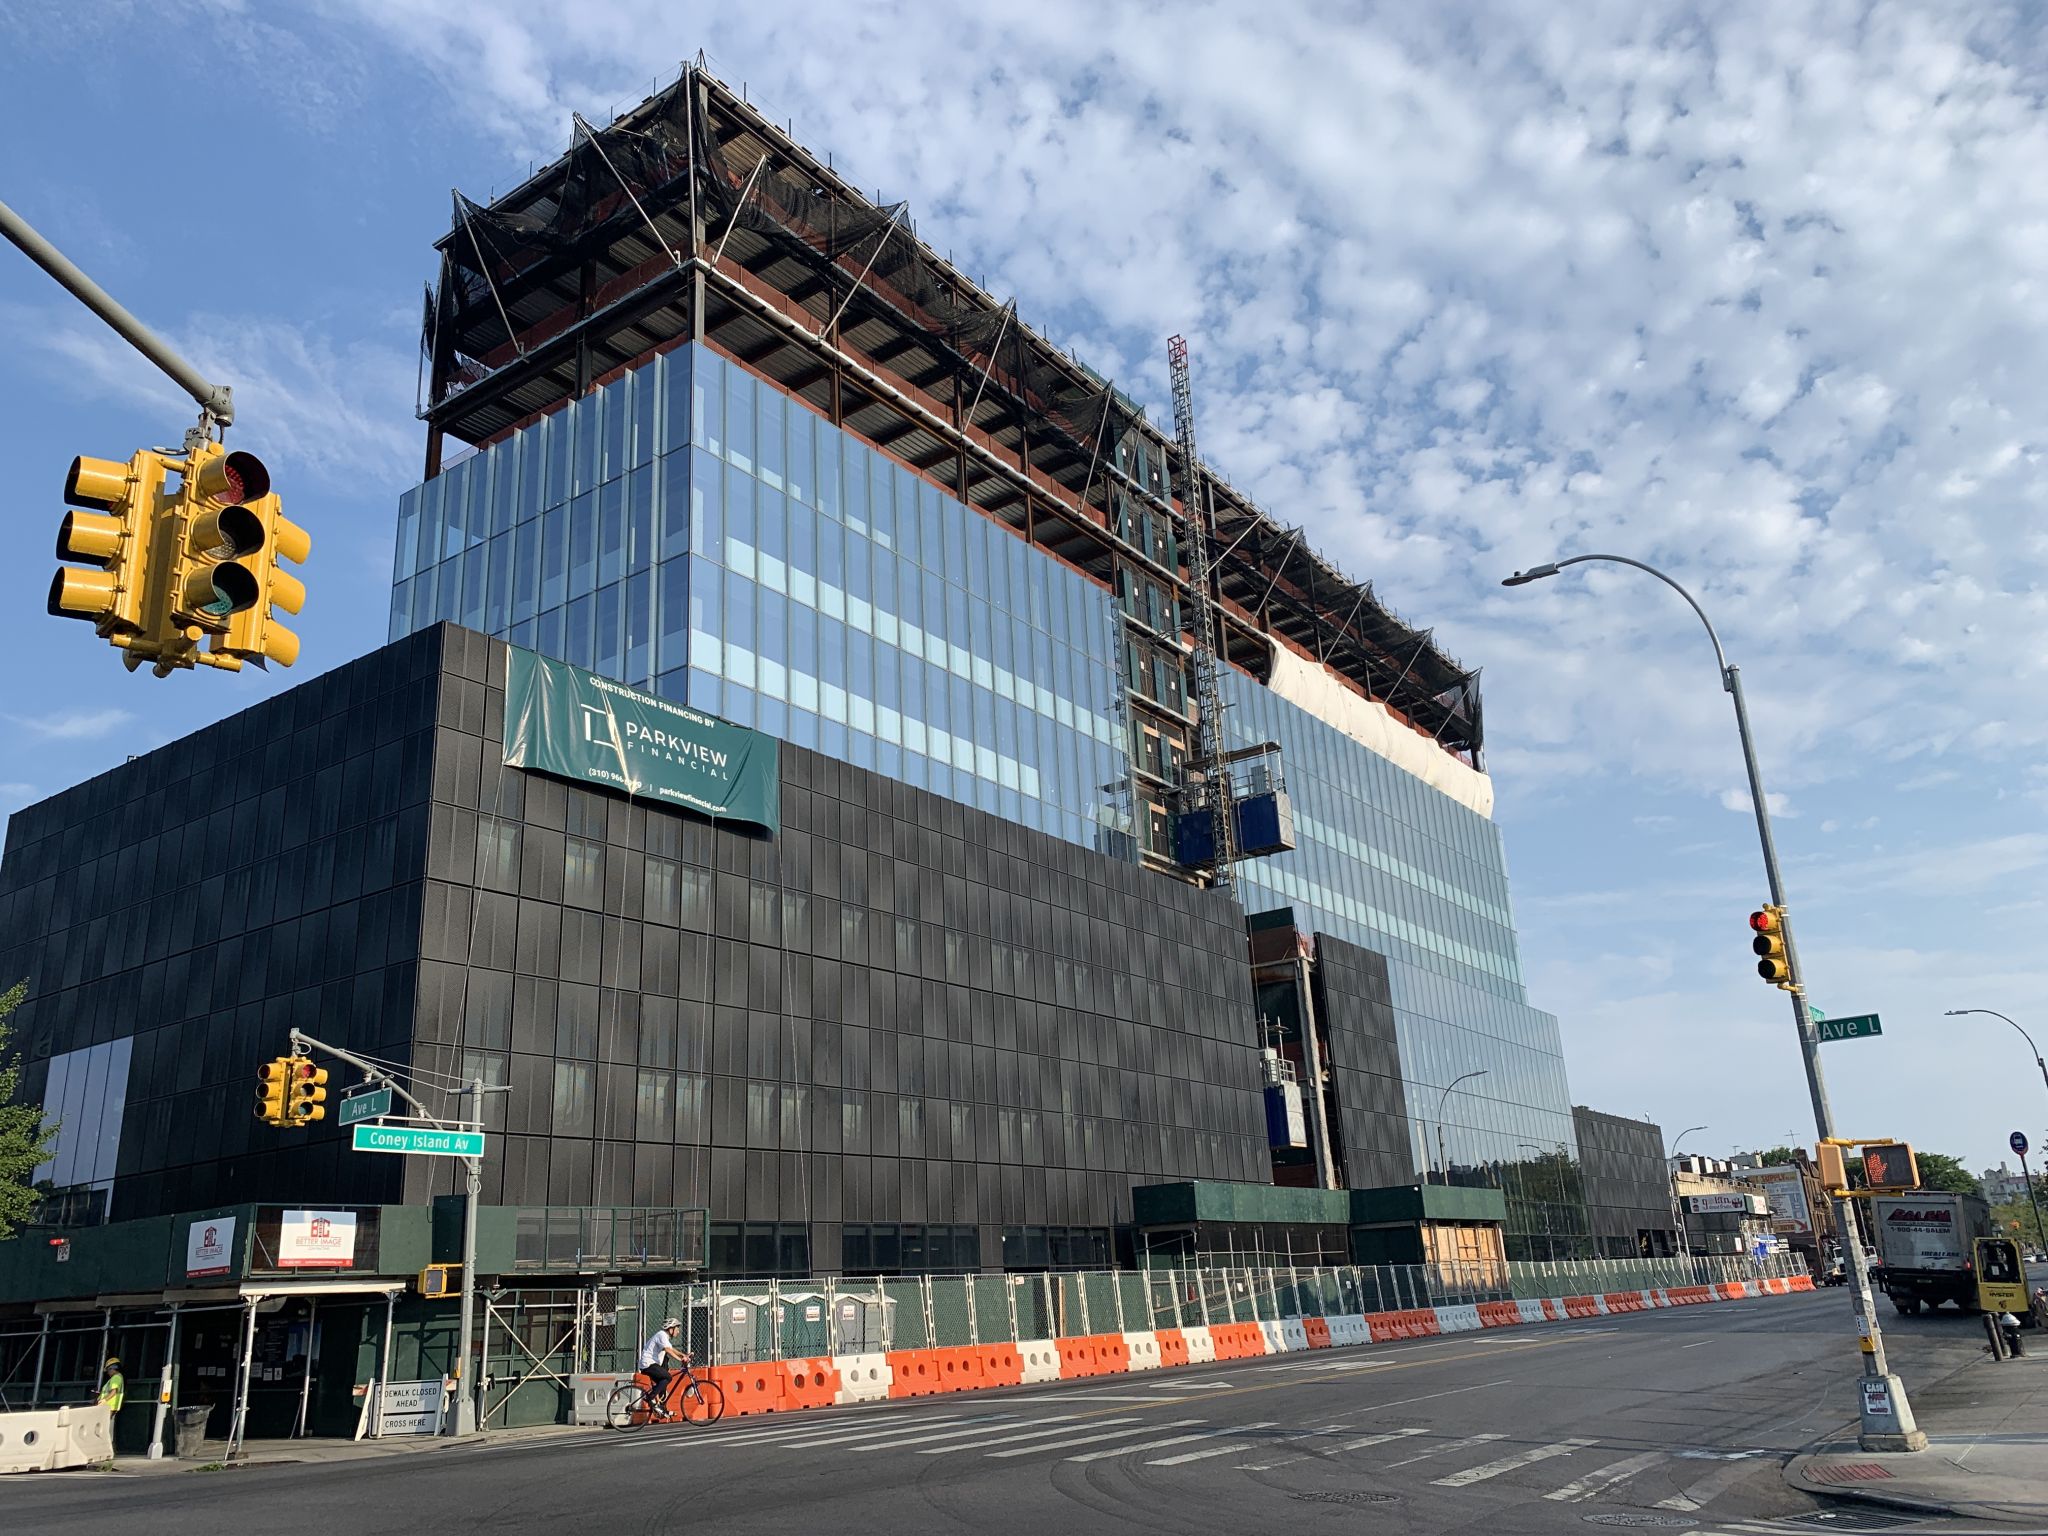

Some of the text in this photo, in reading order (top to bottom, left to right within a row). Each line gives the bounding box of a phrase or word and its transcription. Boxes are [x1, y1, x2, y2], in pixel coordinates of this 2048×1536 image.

[589, 676, 715, 728] CONSTRUCTION FINANCING BY
[626, 721, 727, 767] PARKVIEW
[627, 741, 728, 780] FINANCIAL
[588, 767, 610, 780] (310)
[659, 786, 727, 812] parkviewfinancial.com
[1822, 1016, 1879, 1040] Ave L
[351, 1097, 377, 1117] Ave L
[370, 1131, 469, 1151] Coney Island Av
[1887, 1208, 1952, 1222] SALEM
[295, 1237, 342, 1246] BETTER IMAGE
[378, 1387, 437, 1398] SDEWALK CLOSED
[395, 1400, 418, 1408] AHEAD
[384, 1418, 427, 1428] CROSS HERE
